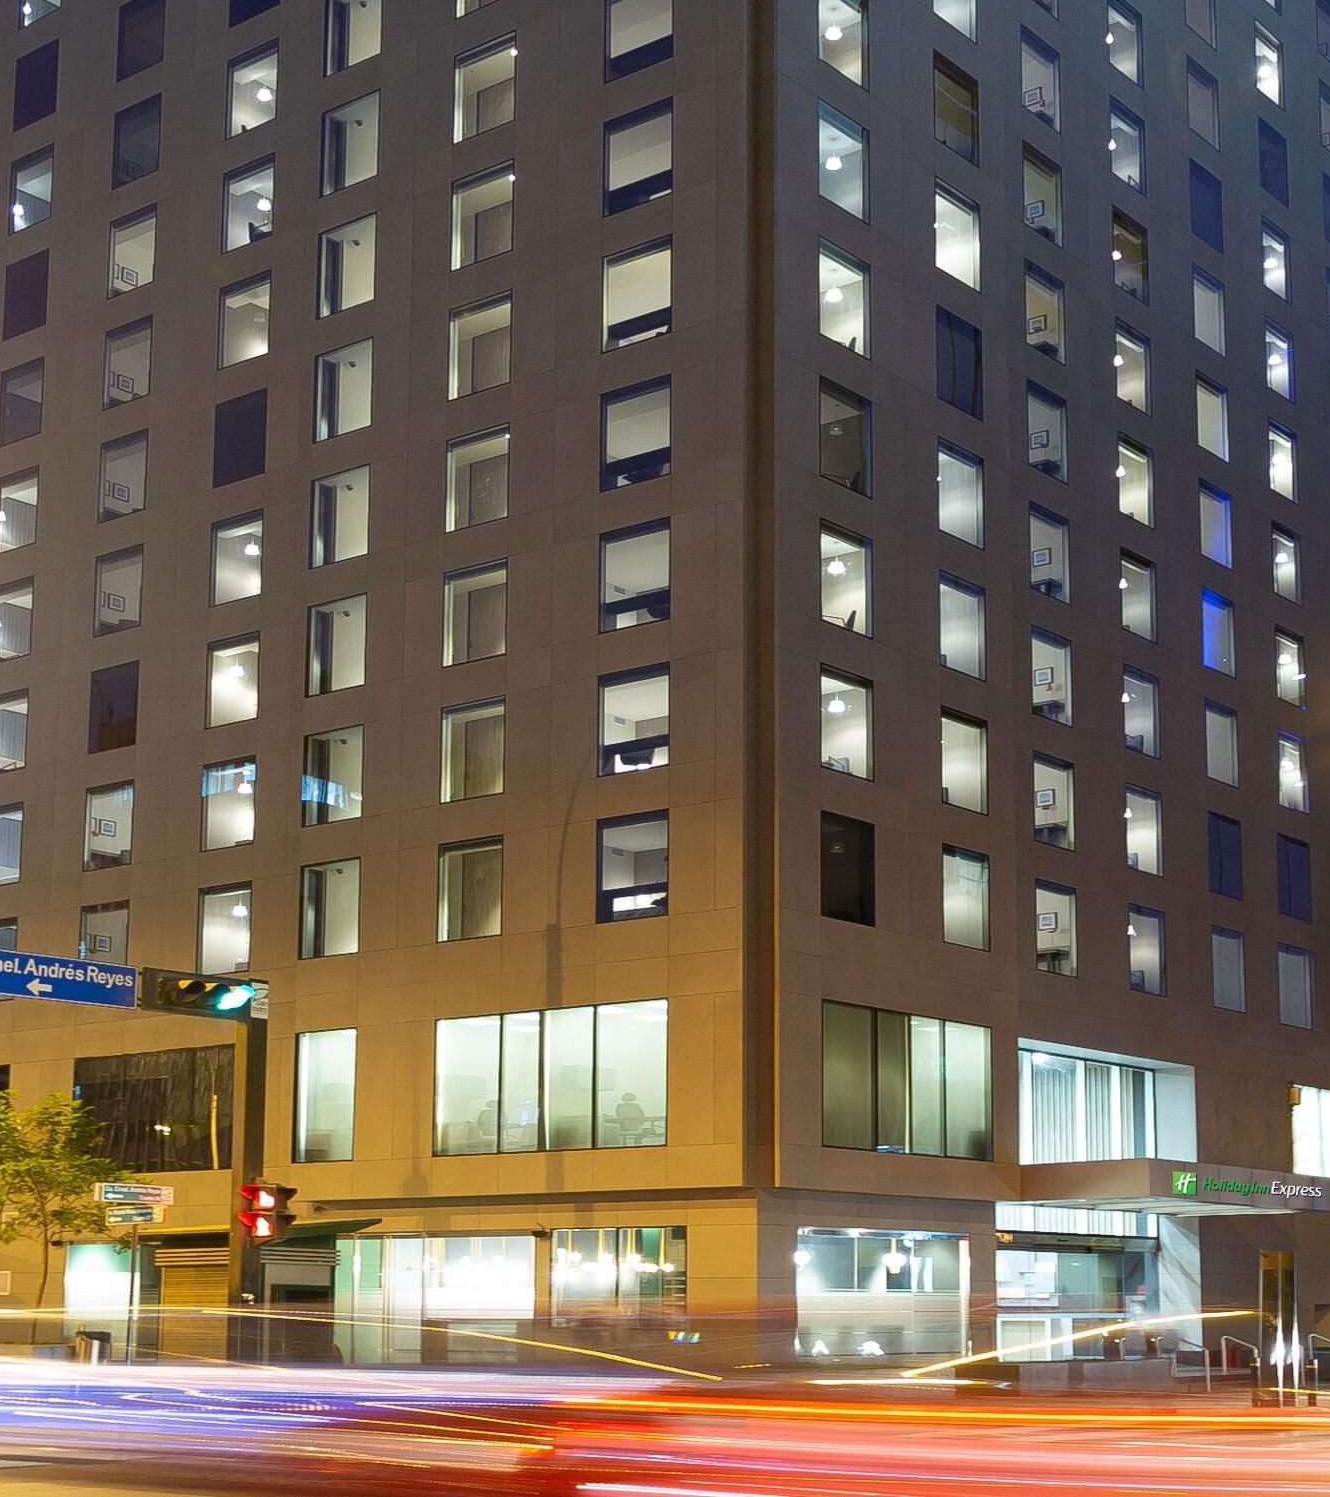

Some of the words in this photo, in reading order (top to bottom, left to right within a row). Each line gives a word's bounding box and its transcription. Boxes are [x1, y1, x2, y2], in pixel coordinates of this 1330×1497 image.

[24, 959, 85, 981] Andrés
[86, 965, 134, 989] Reyes
[1201, 1176, 1251, 1197] Holiday
[1251, 1181, 1271, 1194] Inn
[1270, 1181, 1322, 1199] Express
